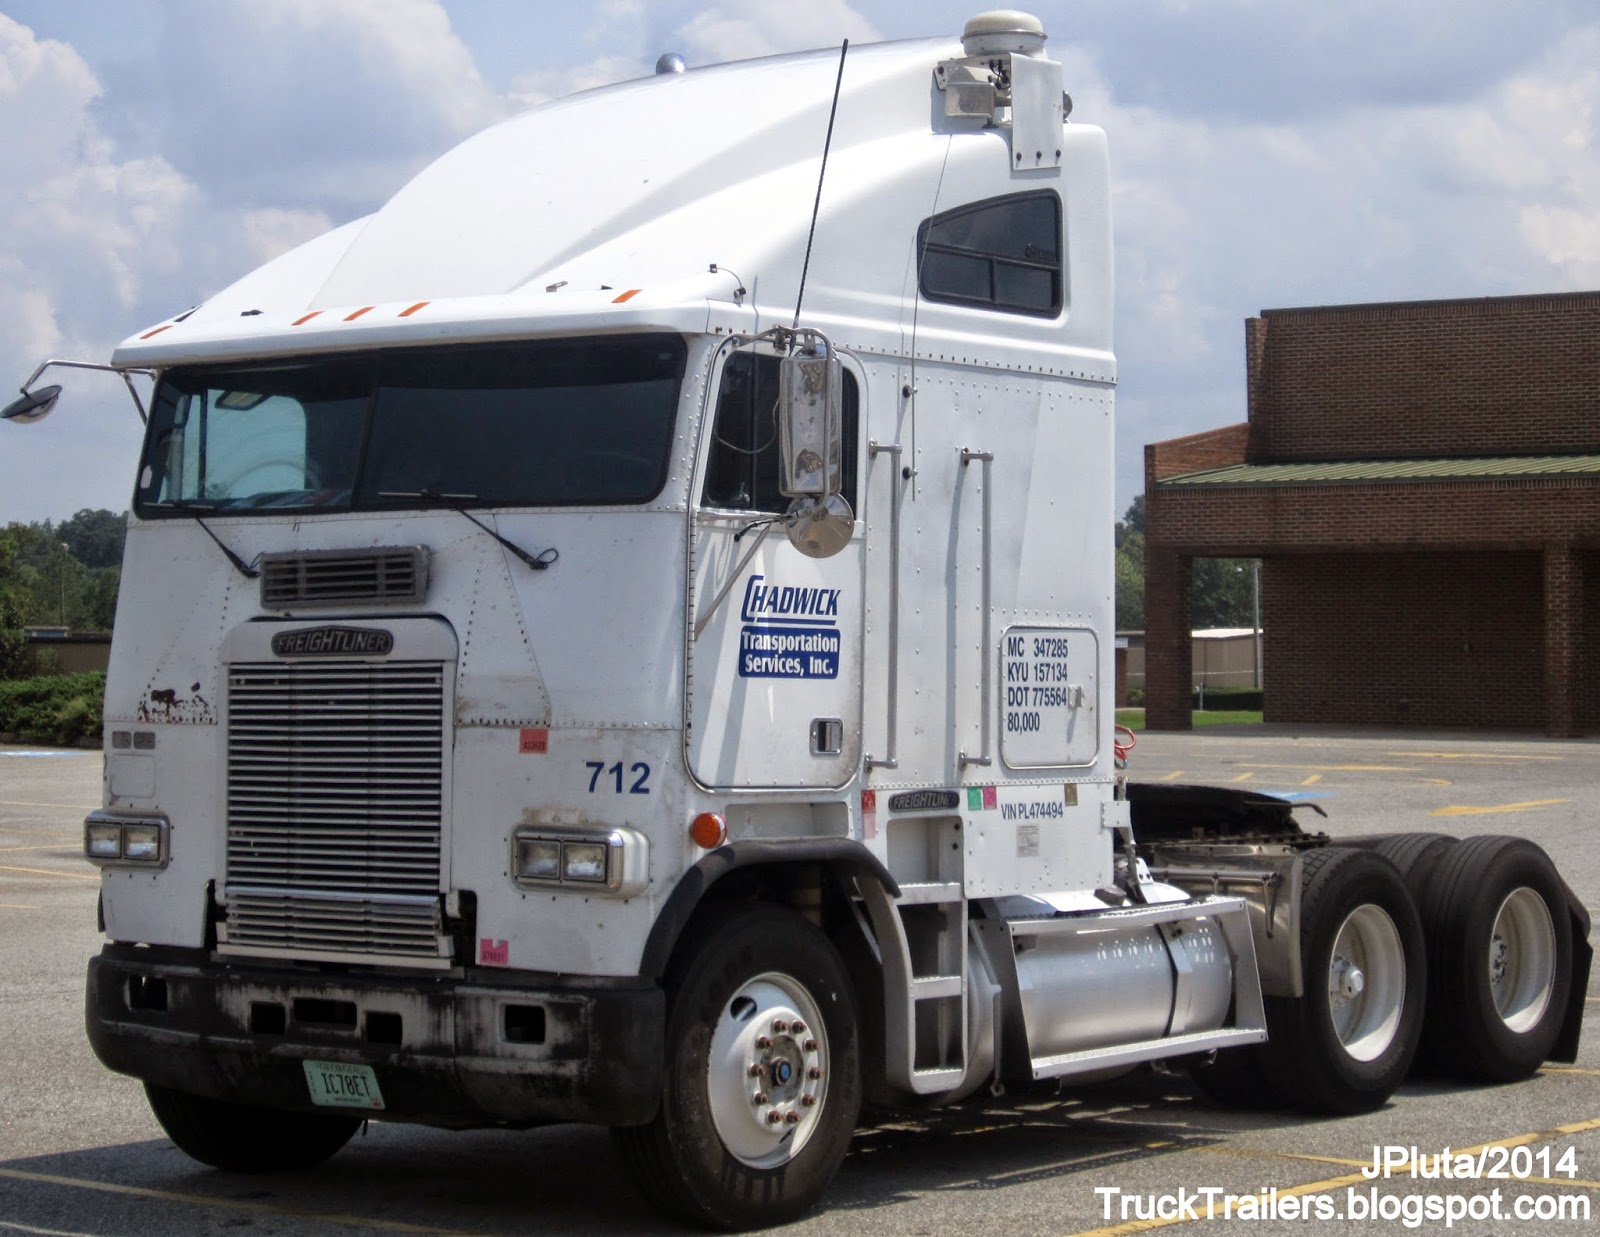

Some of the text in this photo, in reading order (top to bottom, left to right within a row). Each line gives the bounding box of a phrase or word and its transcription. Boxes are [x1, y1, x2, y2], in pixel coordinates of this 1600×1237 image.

[741, 575, 841, 622] CHADWICK
[277, 631, 386, 651] FREIGHTLINER
[742, 632, 838, 654] Transportation
[1008, 637, 1068, 658] MC 347285
[745, 654, 833, 677] Services, Inc.
[1008, 662, 1068, 682] KYU 157134
[1008, 687, 1067, 706] DOT 775564
[1007, 712, 1040, 735] 80,000
[586, 761, 650, 794] 712
[1001, 802, 1063, 820] VIN PL474494
